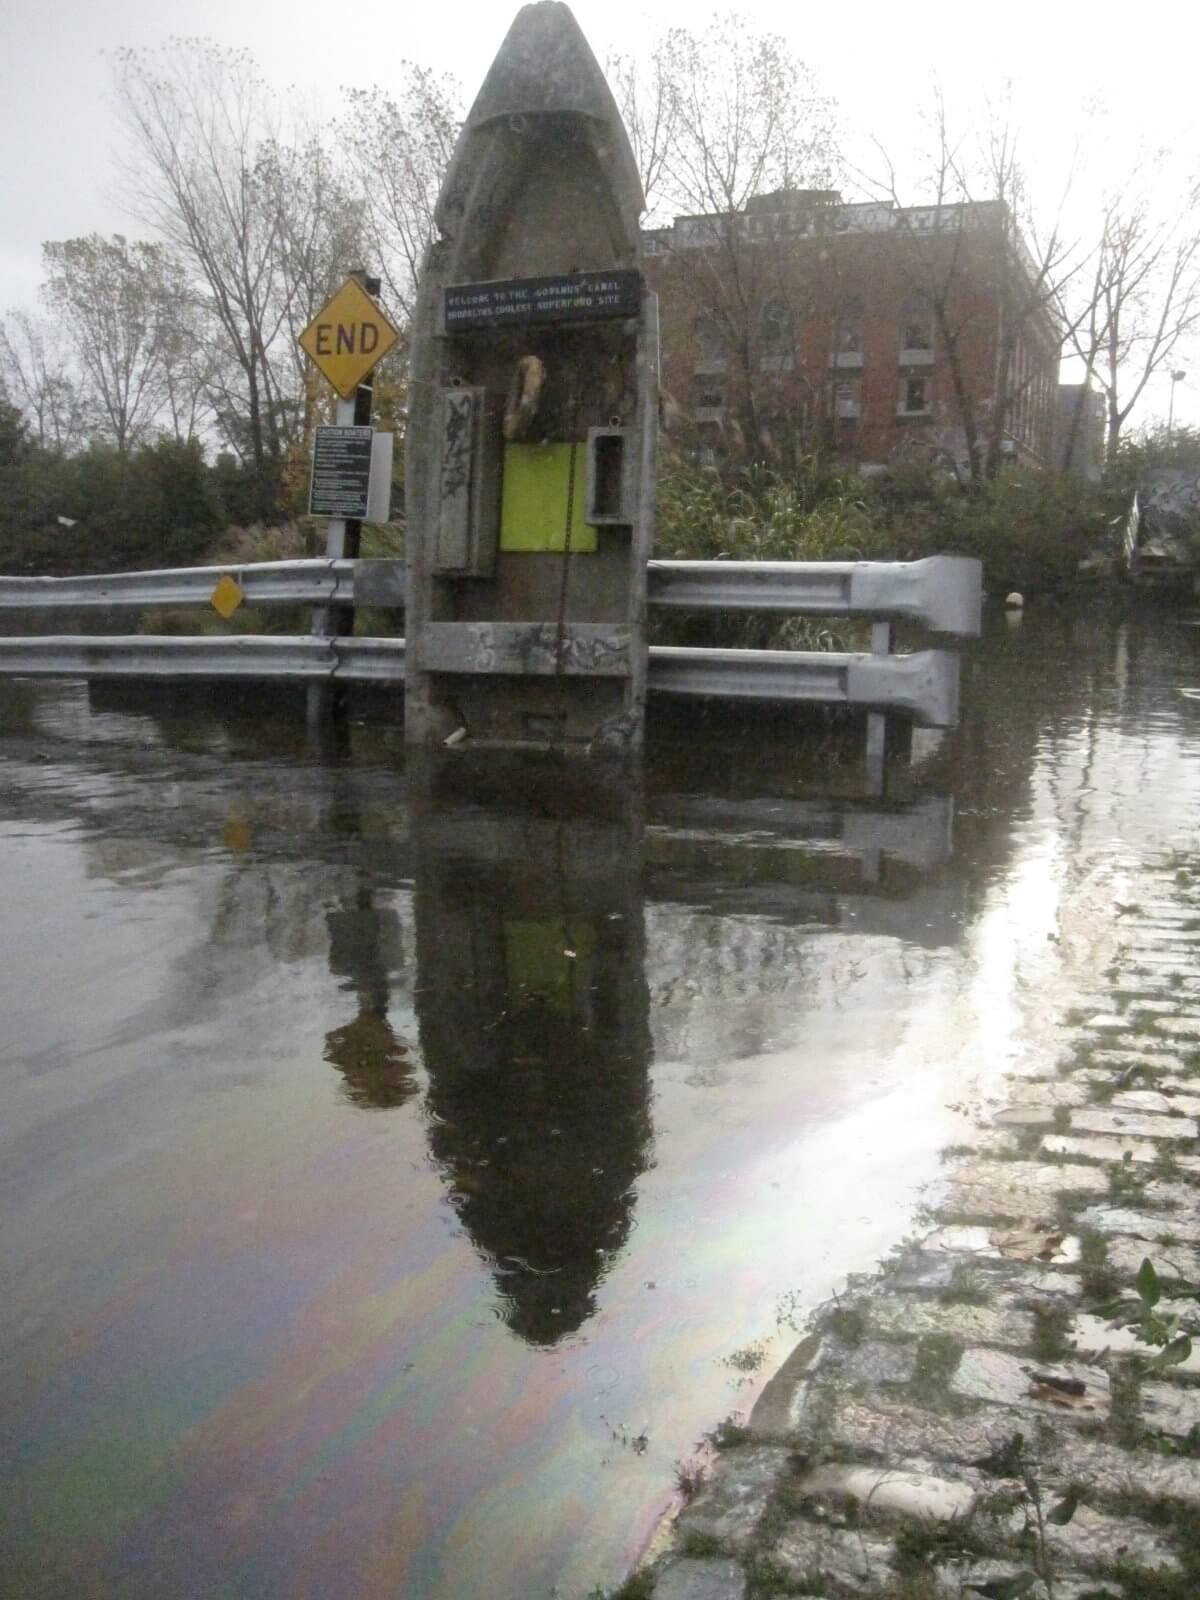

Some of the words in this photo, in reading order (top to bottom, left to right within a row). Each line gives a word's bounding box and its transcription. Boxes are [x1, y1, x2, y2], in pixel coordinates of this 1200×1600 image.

[448, 294, 489, 305] WELCOME
[495, 291, 507, 300] TO
[510, 287, 528, 299] THE
[588, 281, 619, 293] CANAL
[536, 297, 592, 310] SUPERFUND
[598, 295, 619, 305] SITE
[316, 322, 378, 355] END
